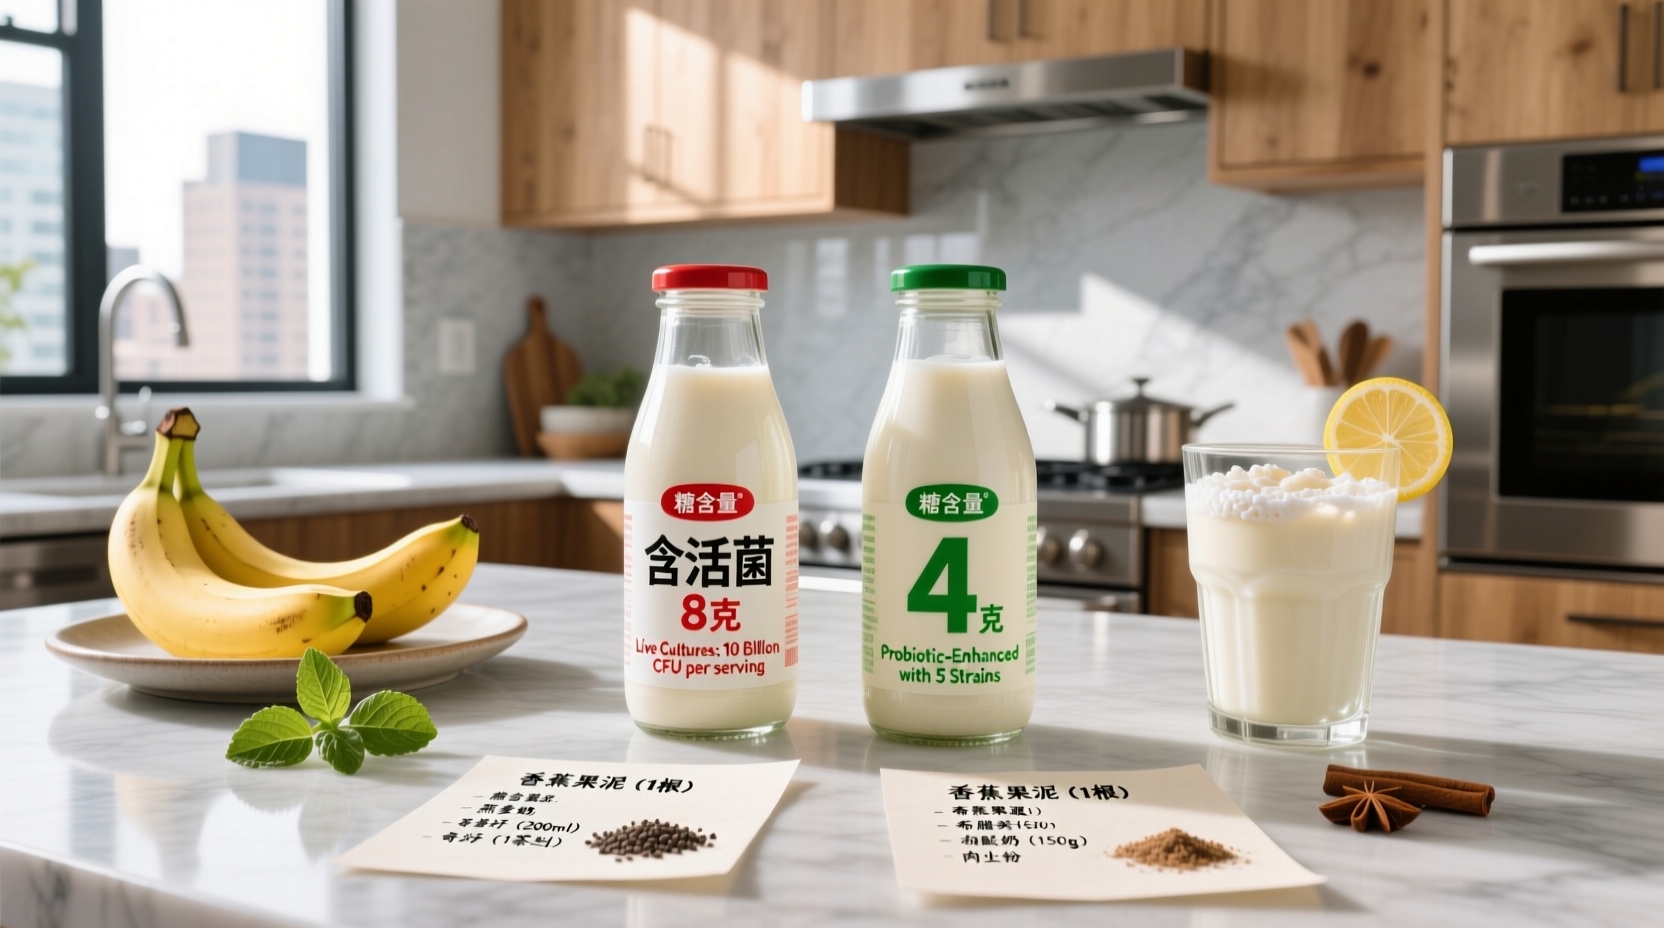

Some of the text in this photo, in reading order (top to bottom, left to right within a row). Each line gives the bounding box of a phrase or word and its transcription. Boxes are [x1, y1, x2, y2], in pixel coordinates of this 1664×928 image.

[673, 490, 738, 514] 糖含量
[918, 490, 984, 515] 糖含量
[644, 533, 774, 588] 含活菌
[680, 593, 741, 632] 8克
[635, 637, 657, 655] Live
[723, 642, 740, 657] 10
[881, 643, 1019, 663] Probiotic-Enhanced
[653, 658, 765, 679] CFU per serving
[899, 667, 1001, 684] with 5 Strains
